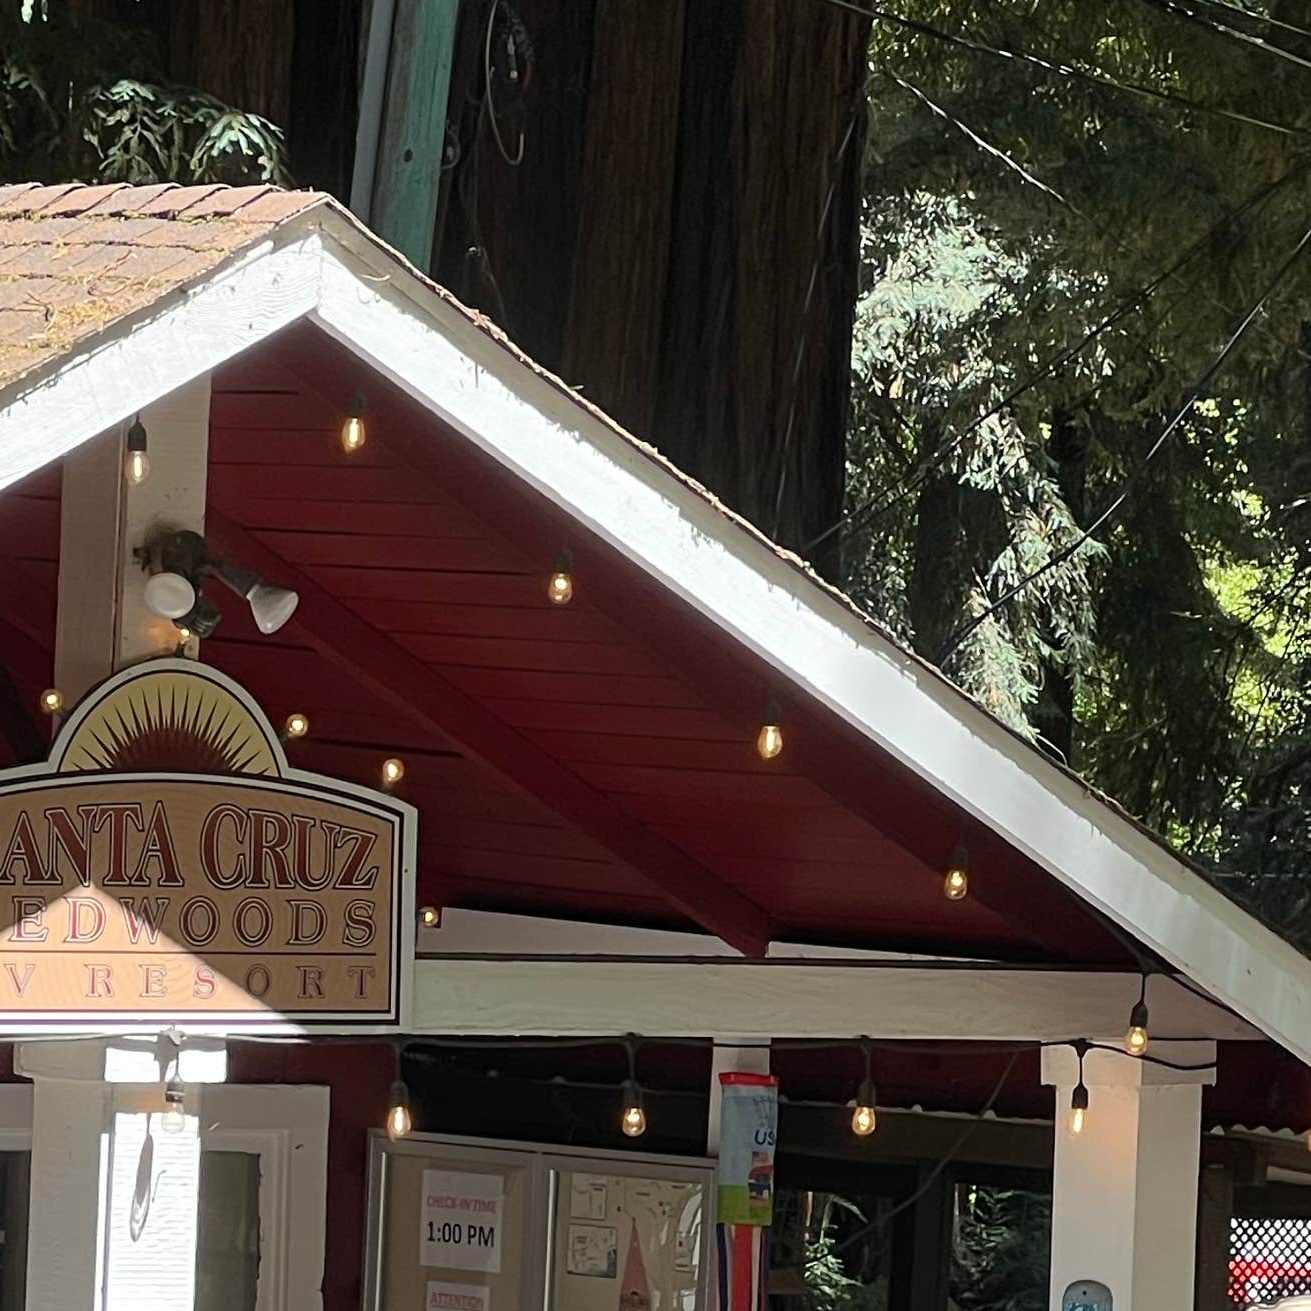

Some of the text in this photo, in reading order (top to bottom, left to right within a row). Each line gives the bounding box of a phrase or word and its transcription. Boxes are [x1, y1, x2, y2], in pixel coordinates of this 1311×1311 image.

[200, 803, 379, 890] CRUZ
[85, 963, 377, 1000] RESORT
[426, 1221, 495, 1248] 1:00 PM
